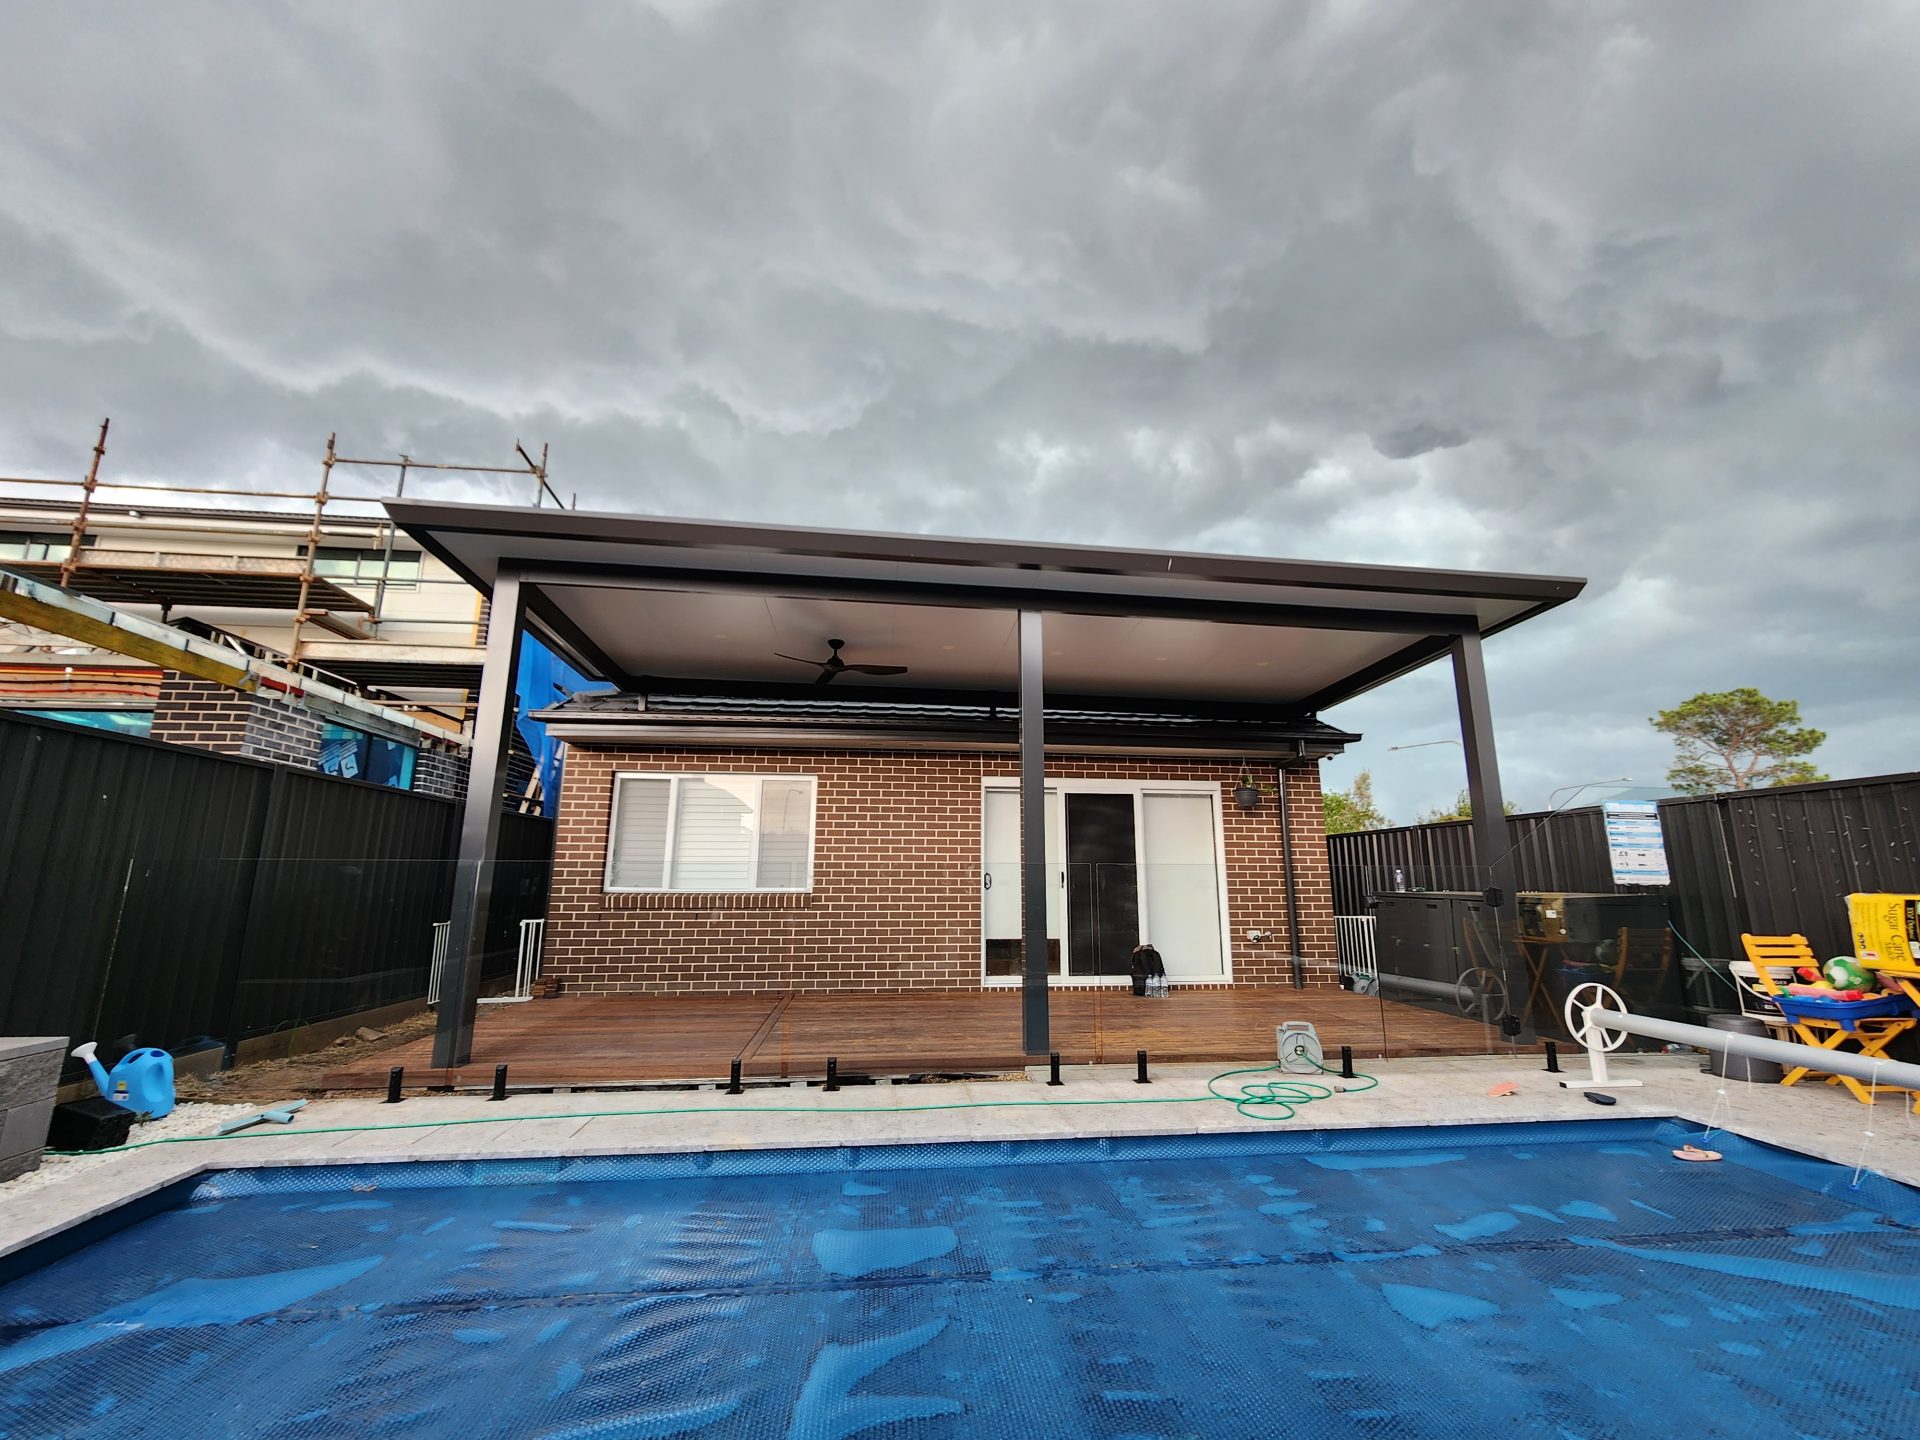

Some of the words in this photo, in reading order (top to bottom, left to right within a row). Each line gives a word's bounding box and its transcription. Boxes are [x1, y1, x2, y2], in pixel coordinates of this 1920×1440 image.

[1883, 903, 1901, 930] Sugar
[1884, 942, 1897, 961] Mulch
[1891, 935, 1907, 961] Cane
